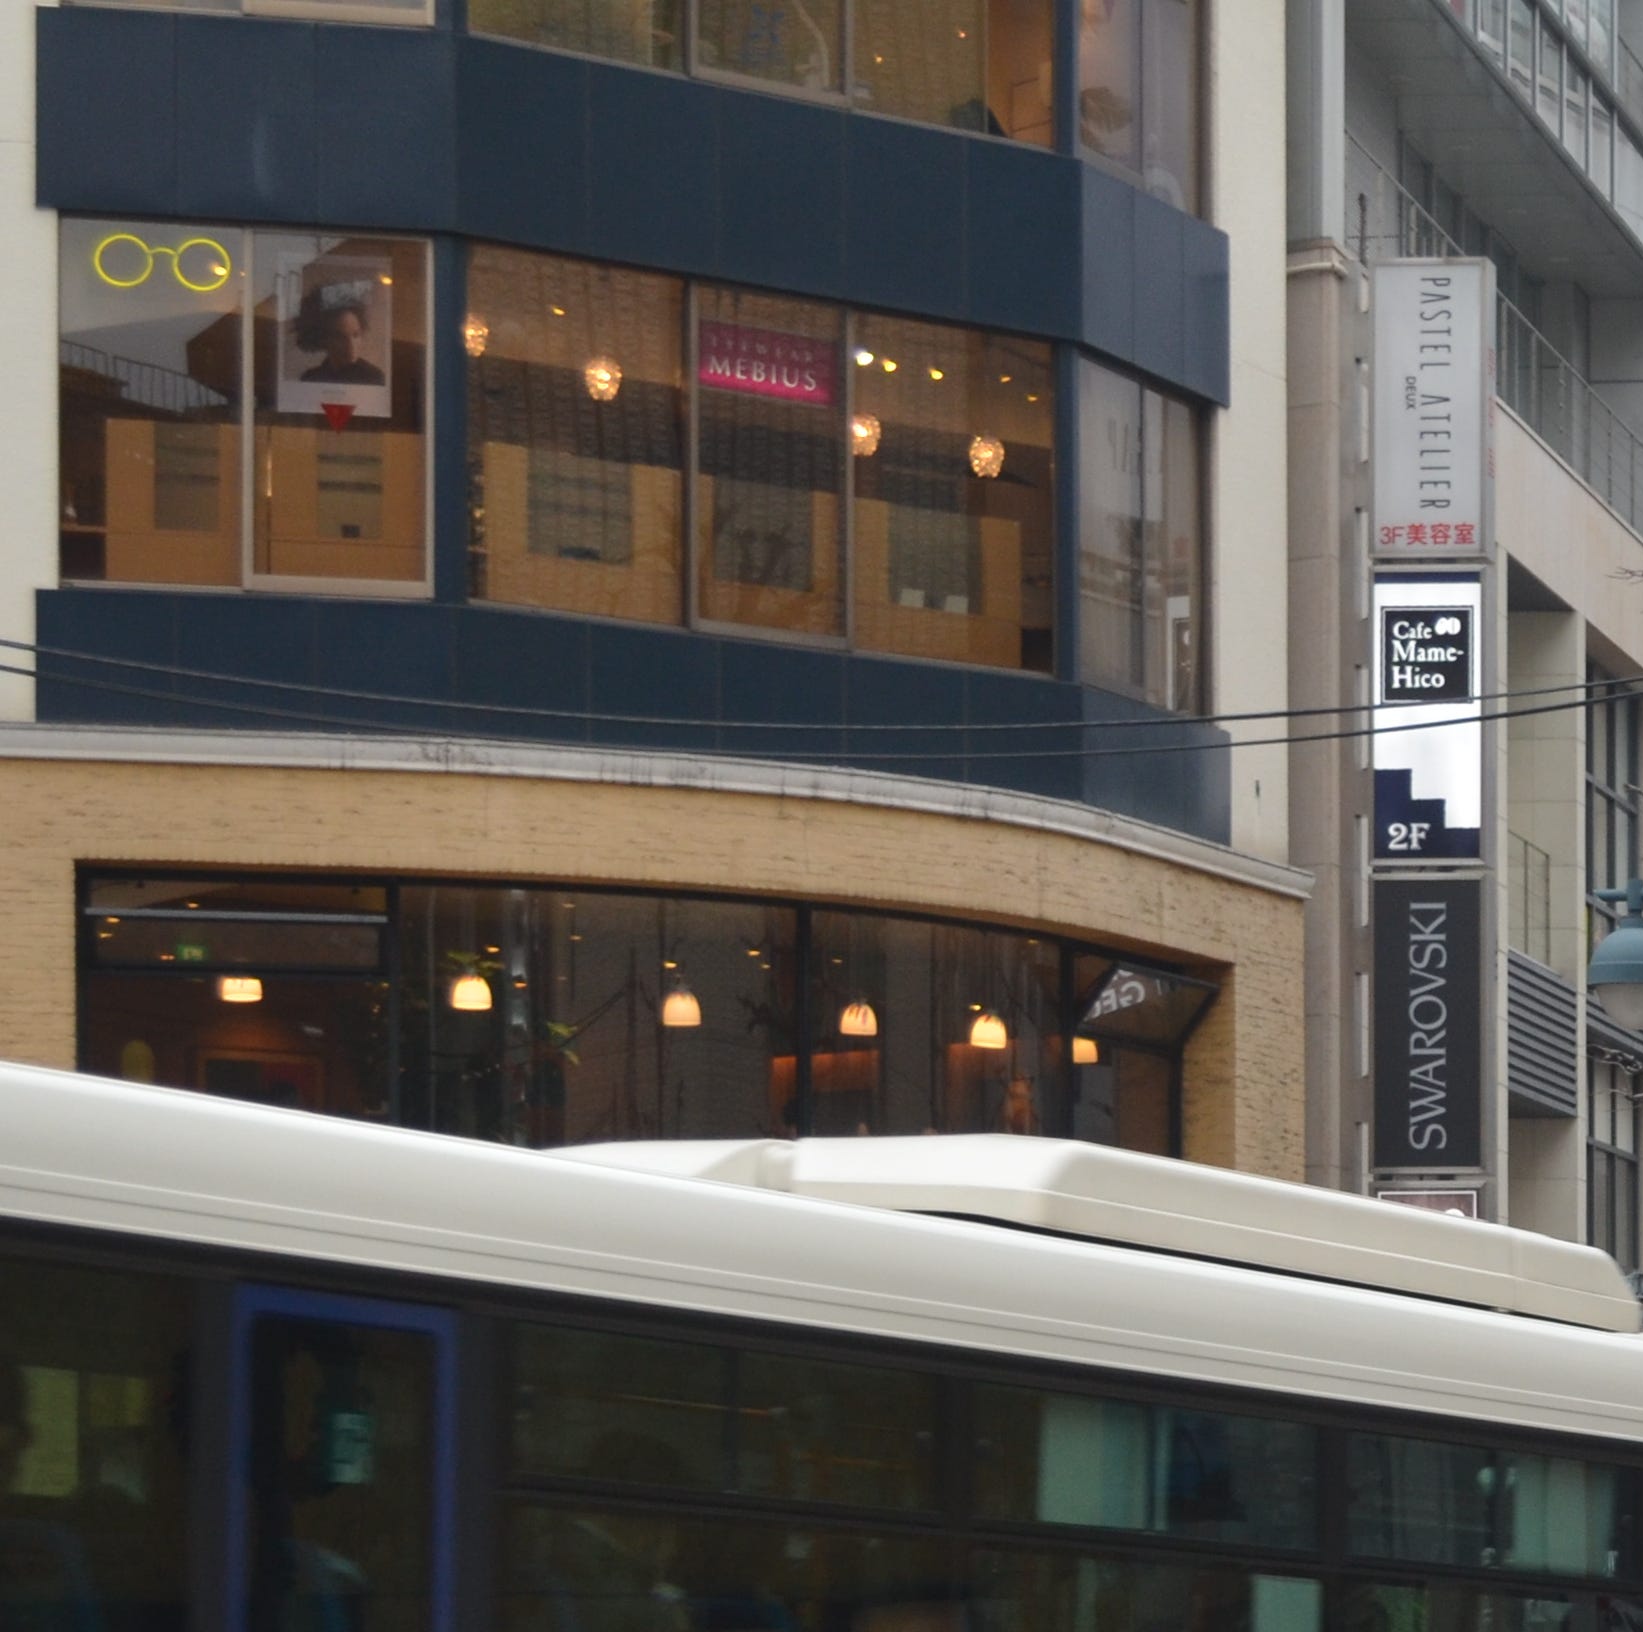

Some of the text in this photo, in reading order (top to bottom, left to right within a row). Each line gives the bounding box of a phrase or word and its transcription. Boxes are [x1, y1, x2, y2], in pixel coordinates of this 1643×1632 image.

[709, 355, 817, 392] MEBIUS
[1405, 376, 1417, 410] DEUX
[1420, 277, 1451, 509] PASTEL ATELIER
[1380, 522, 1475, 546] 3F美容室
[1392, 620, 1433, 641] Cafe
[1391, 640, 1464, 663] Mame-
[1391, 665, 1446, 689] Hico
[1388, 822, 1431, 851] 2F
[1408, 901, 1447, 1150] SWAROVSKI
